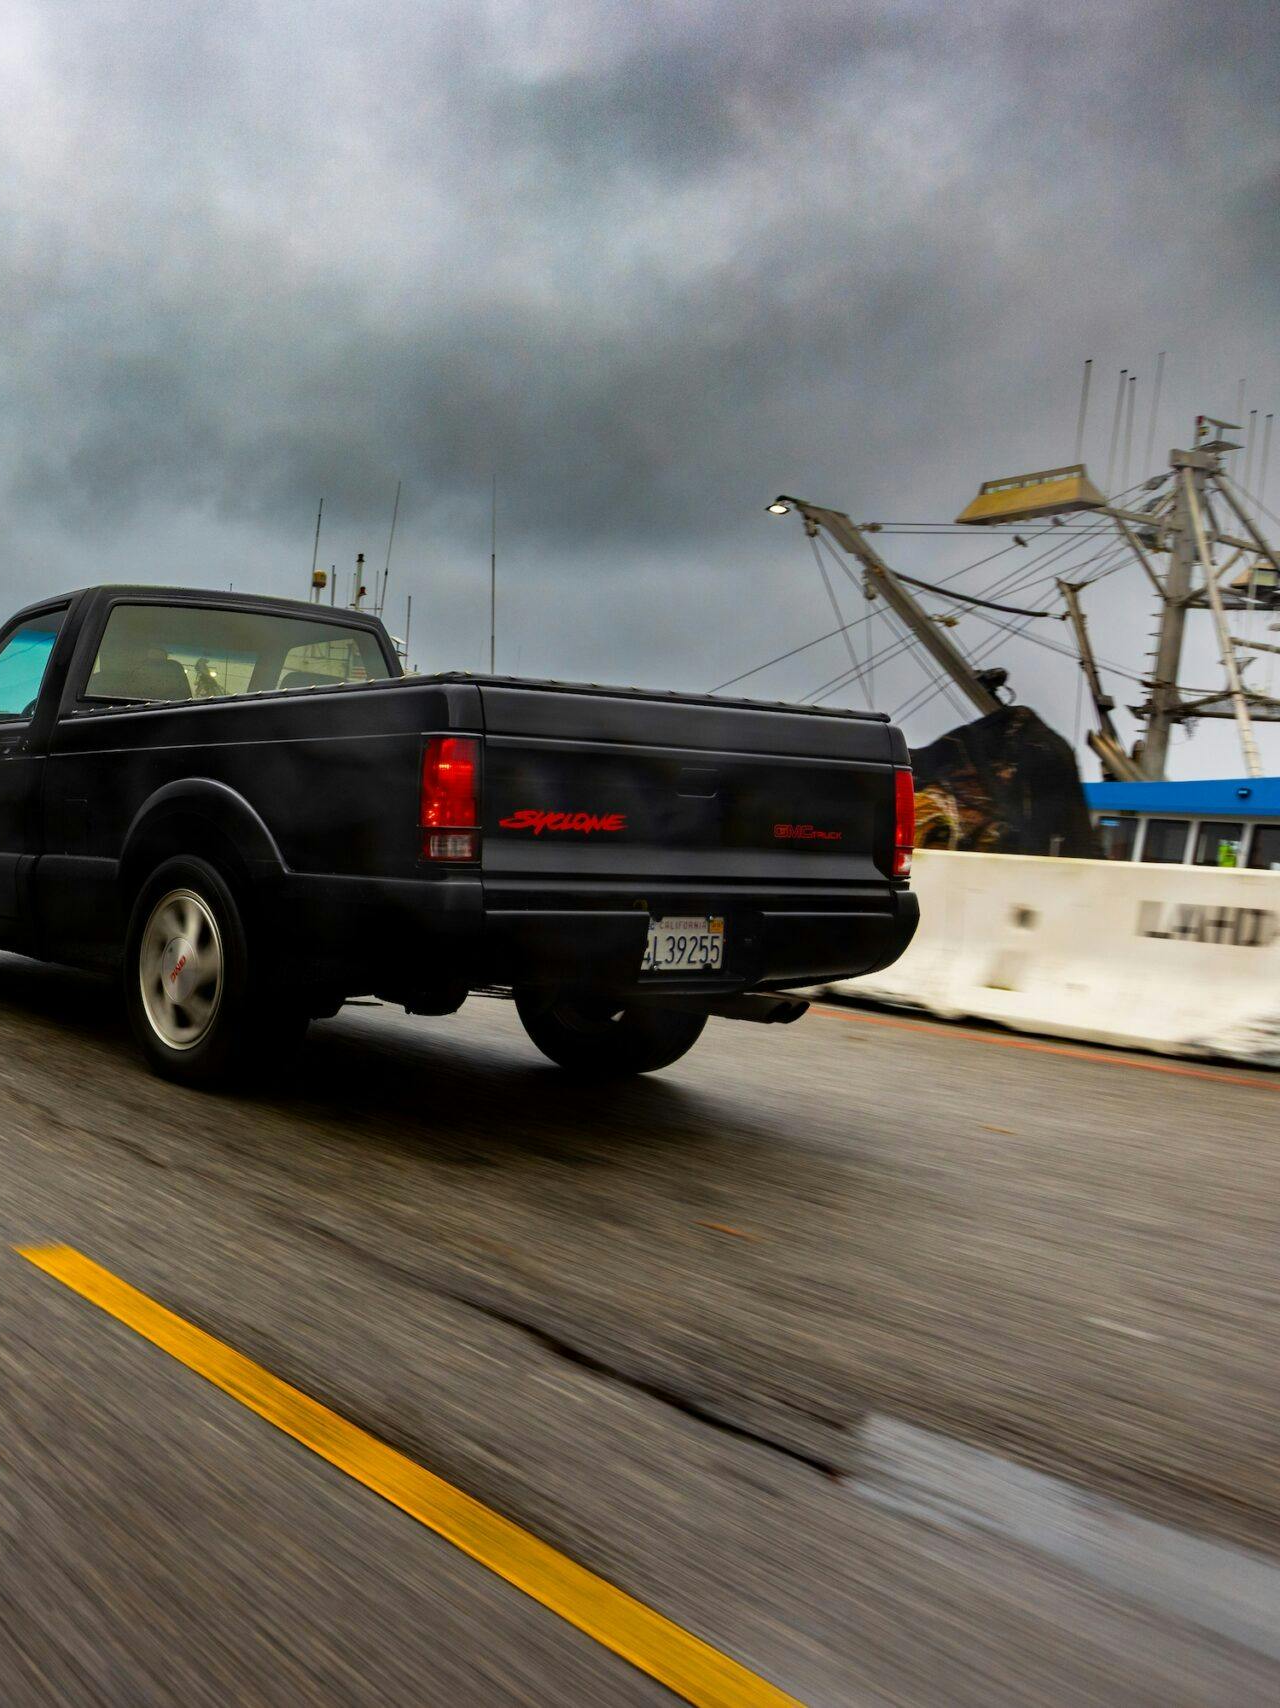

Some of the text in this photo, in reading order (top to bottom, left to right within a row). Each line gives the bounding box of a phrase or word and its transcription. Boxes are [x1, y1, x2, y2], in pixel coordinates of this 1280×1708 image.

[498, 809, 628, 836] SYCLONE
[774, 824, 813, 838] GMC
[660, 920, 706, 930] CALIFORNIA
